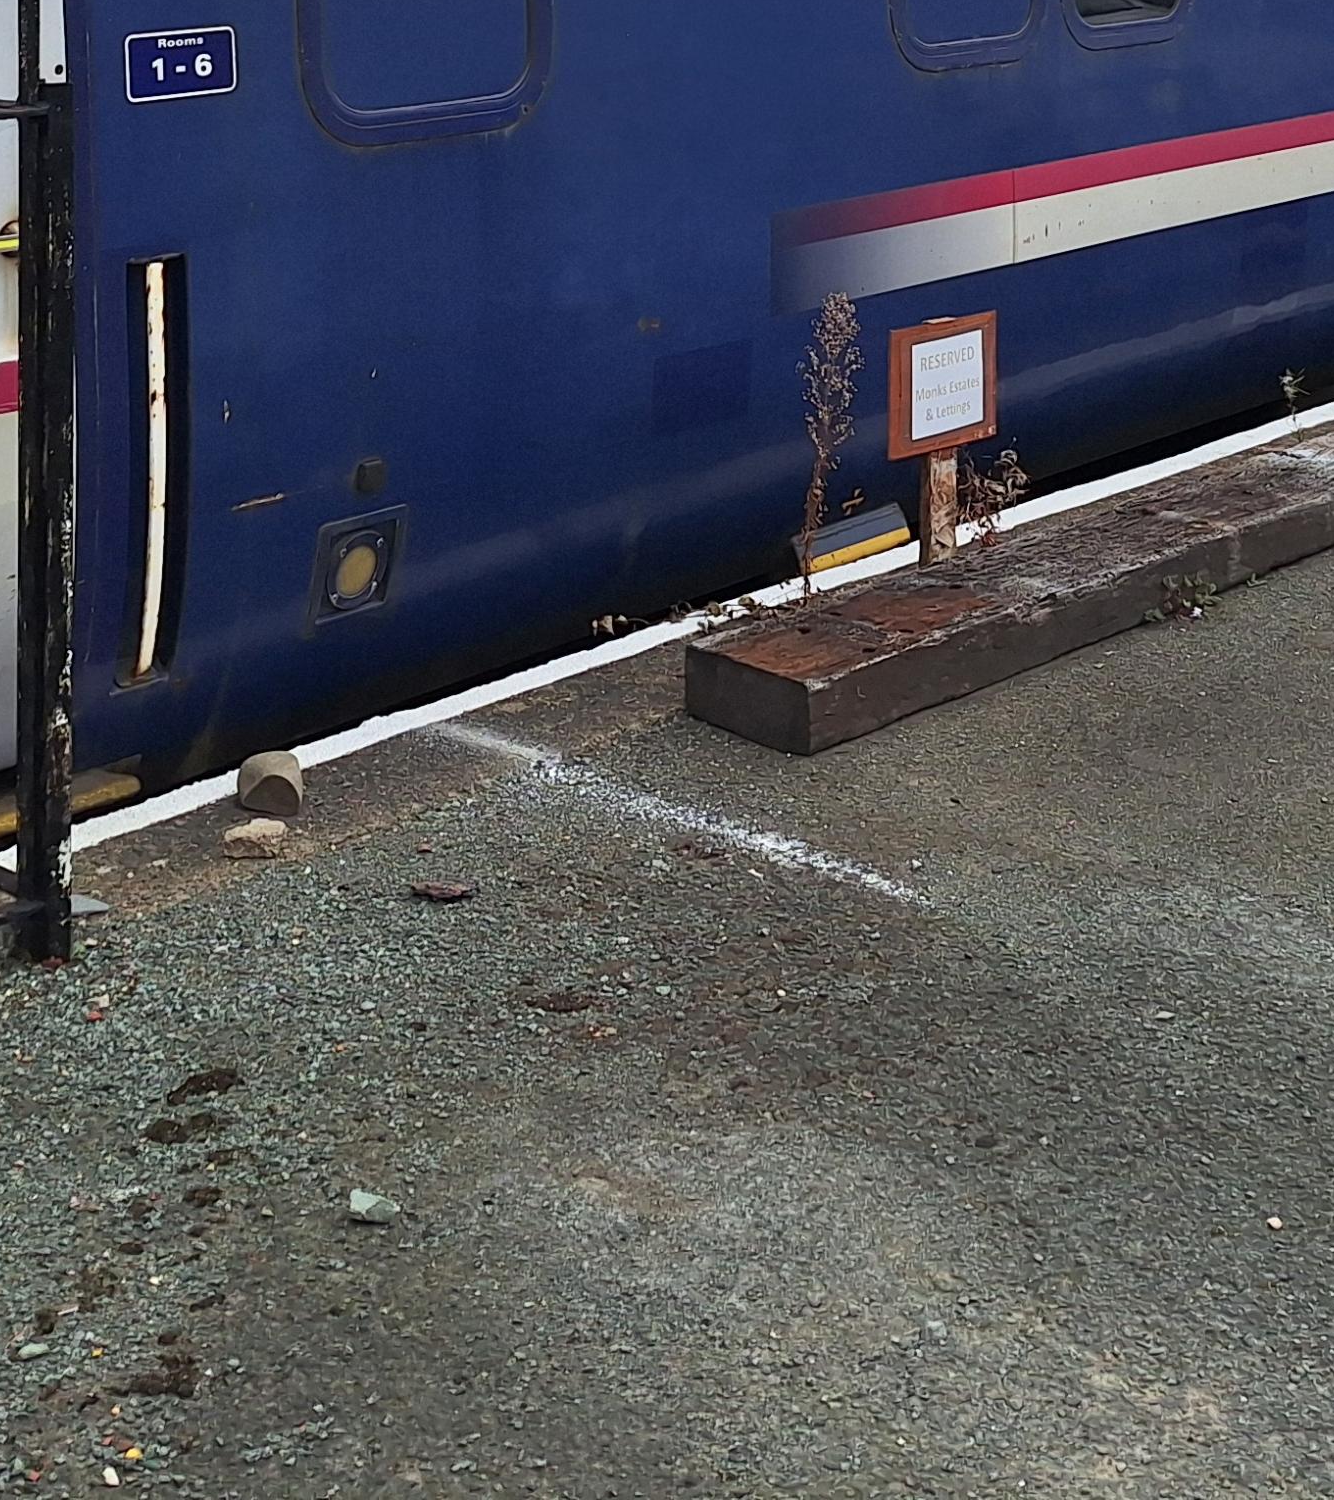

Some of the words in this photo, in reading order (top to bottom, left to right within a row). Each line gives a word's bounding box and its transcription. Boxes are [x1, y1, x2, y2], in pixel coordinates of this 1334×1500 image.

[157, 36, 204, 48] Rooms
[920, 346, 975, 373] RESERVED
[915, 383, 947, 403] Monks
[949, 377, 980, 394] Estates
[925, 407, 934, 421] &
[936, 400, 971, 419] Lettings
